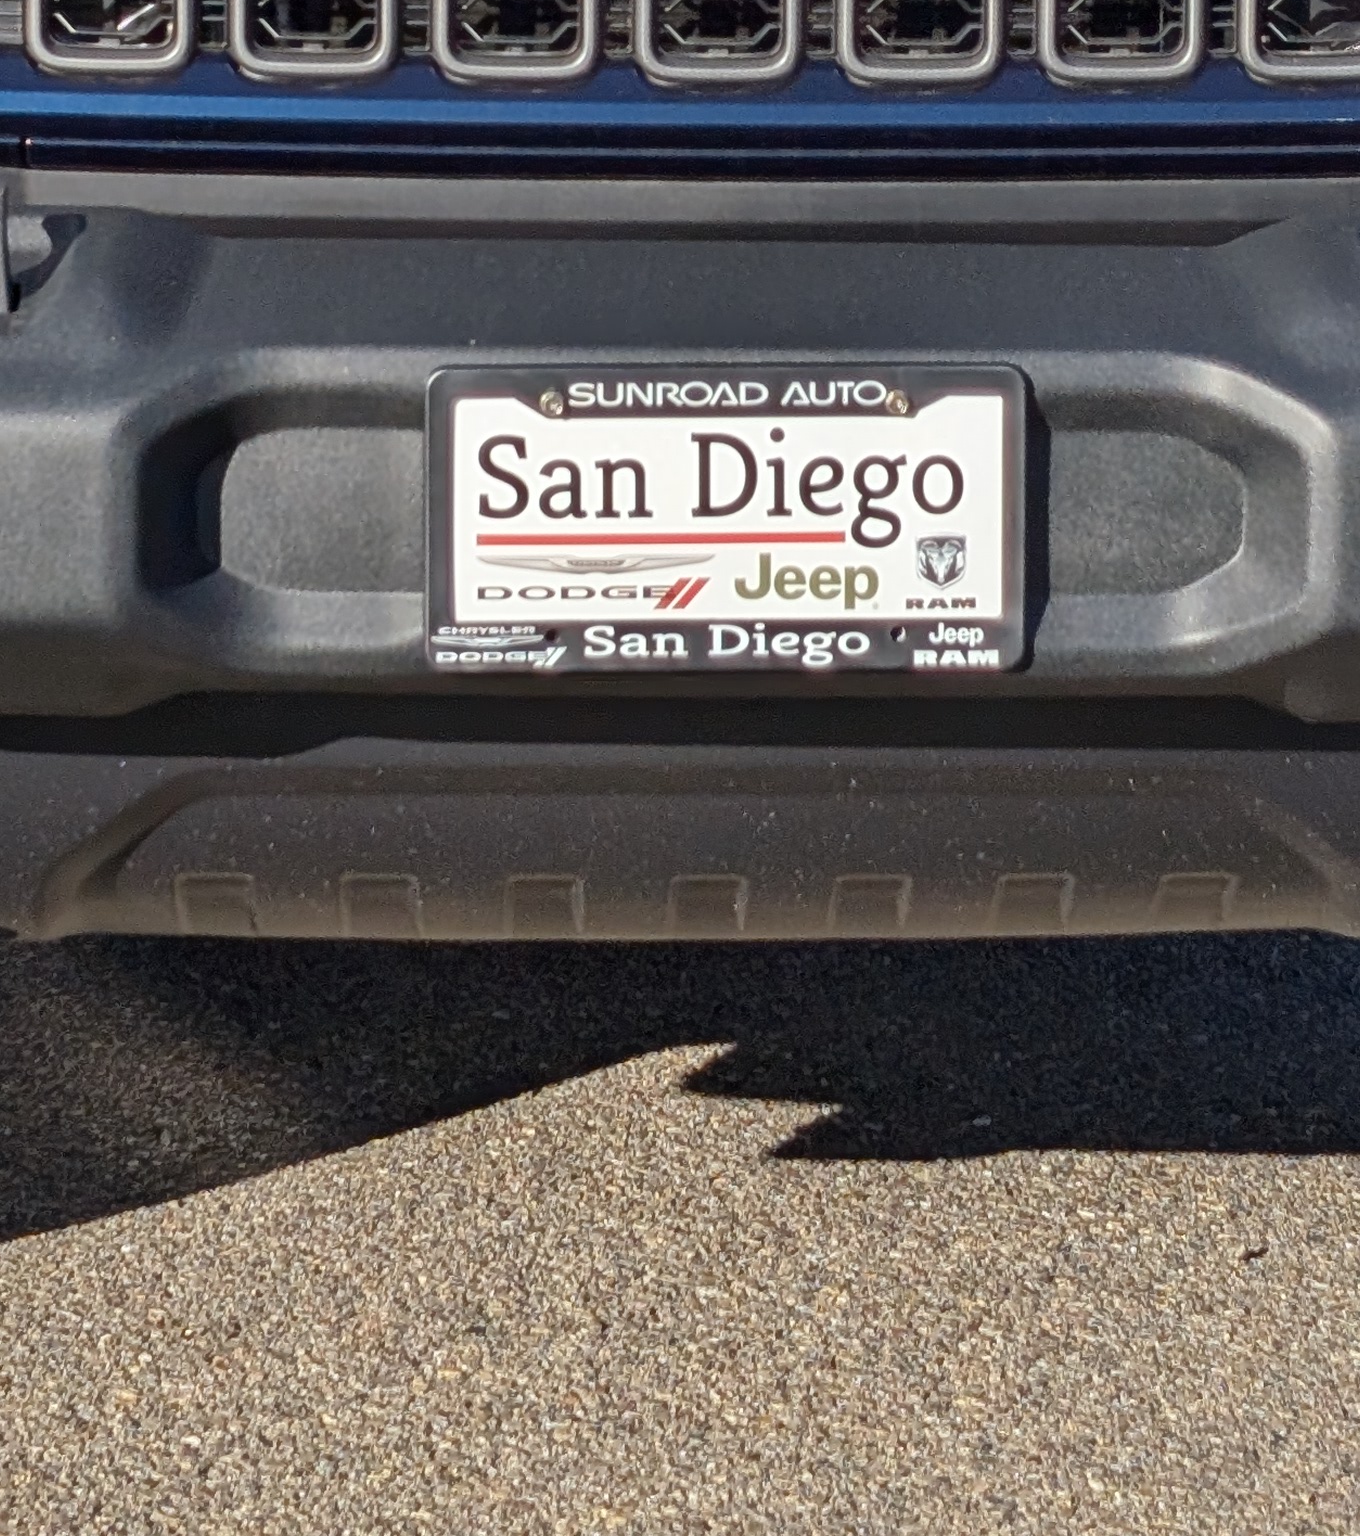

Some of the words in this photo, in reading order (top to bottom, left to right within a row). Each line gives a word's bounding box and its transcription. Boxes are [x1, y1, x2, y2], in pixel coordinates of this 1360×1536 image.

[568, 381, 769, 408] SUNROAD
[780, 380, 887, 407] AUTO
[478, 434, 653, 519] San
[691, 427, 964, 549] Diego
[734, 552, 879, 610] Jeep
[477, 585, 676, 600] DODGE
[905, 597, 976, 609] RAM
[437, 625, 536, 635] CHRYSLER
[928, 621, 984, 647] Jeep
[583, 624, 688, 659] San
[708, 622, 870, 668] Diego
[435, 651, 553, 664] DODGE
[913, 649, 999, 668] RAM
